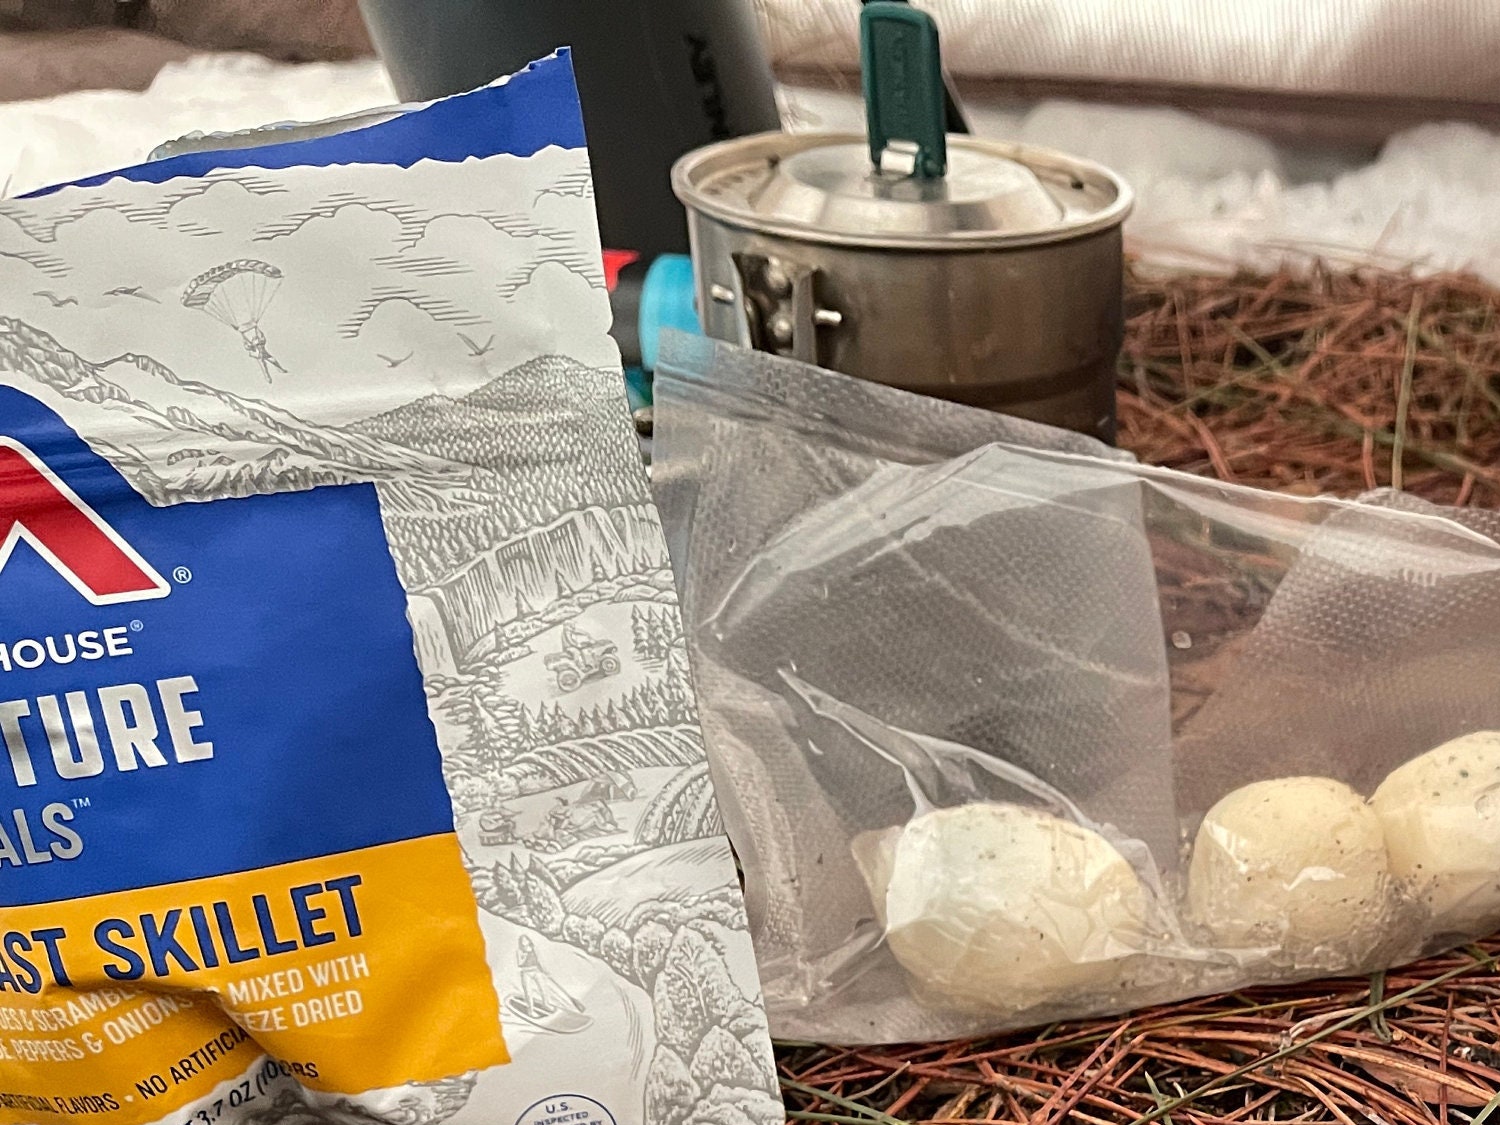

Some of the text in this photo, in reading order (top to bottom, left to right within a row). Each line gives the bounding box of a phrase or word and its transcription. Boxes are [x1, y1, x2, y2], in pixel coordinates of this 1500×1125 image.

[94, 874, 362, 982] SKILLET
[228, 968, 304, 1005] MIXED
[306, 952, 370, 987] WITH
[10, 1038, 85, 1061] PEPPERS
[81, 1032, 103, 1054] &
[292, 990, 363, 1028] DRIED
[53, 1092, 120, 1114] FLAVORS
[135, 1074, 168, 1100] NO
[170, 1025, 251, 1085] ARTIFICIA
[229, 1081, 257, 1108] OZ
[545, 1102, 573, 1114] U.S.
